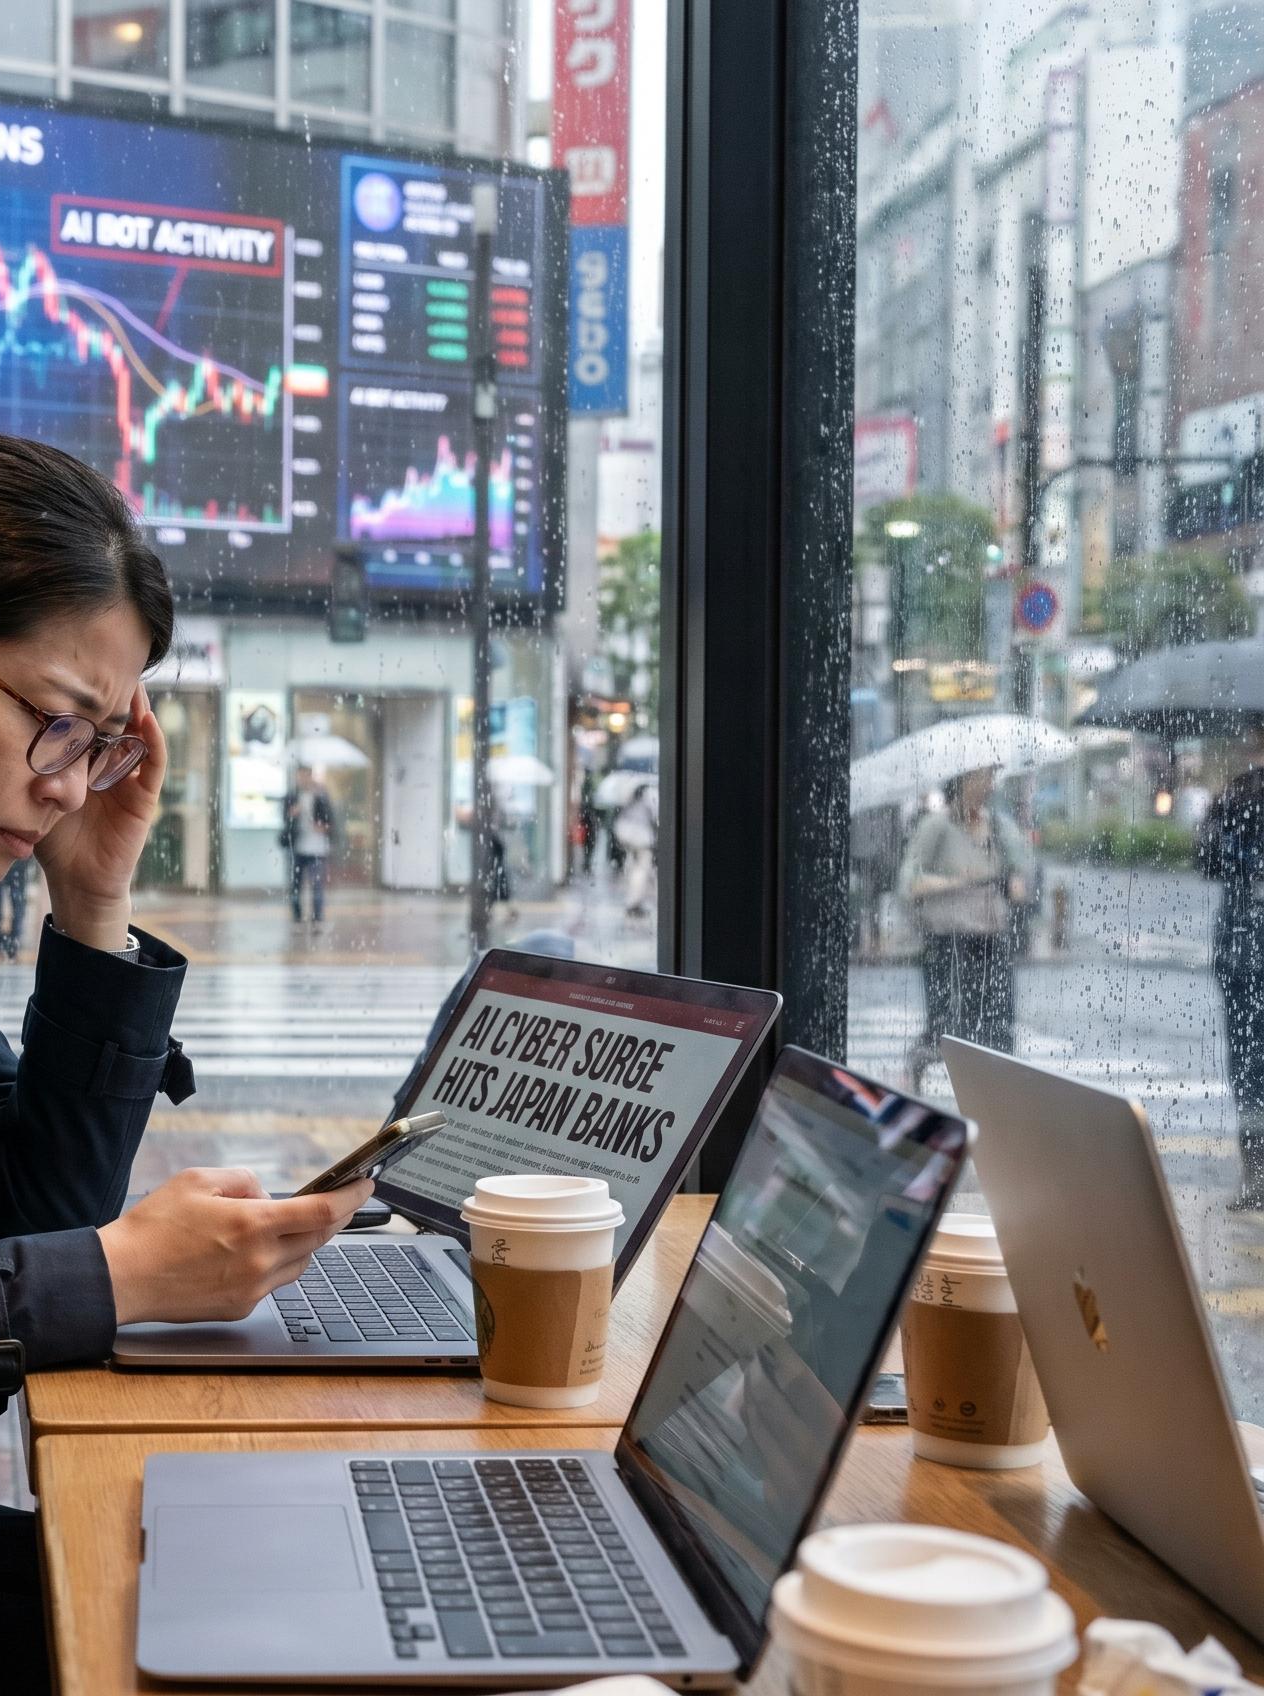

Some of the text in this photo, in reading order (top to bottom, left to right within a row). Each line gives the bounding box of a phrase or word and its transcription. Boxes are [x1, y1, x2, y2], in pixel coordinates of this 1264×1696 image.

[59, 210, 275, 264] AI BOT ACTIVITY
[459, 1004, 676, 1094] AI CYBER SURGE
[432, 1056, 500, 1117] HITS
[485, 1071, 582, 1136] JAPAN
[566, 1091, 676, 1163] BANKS
